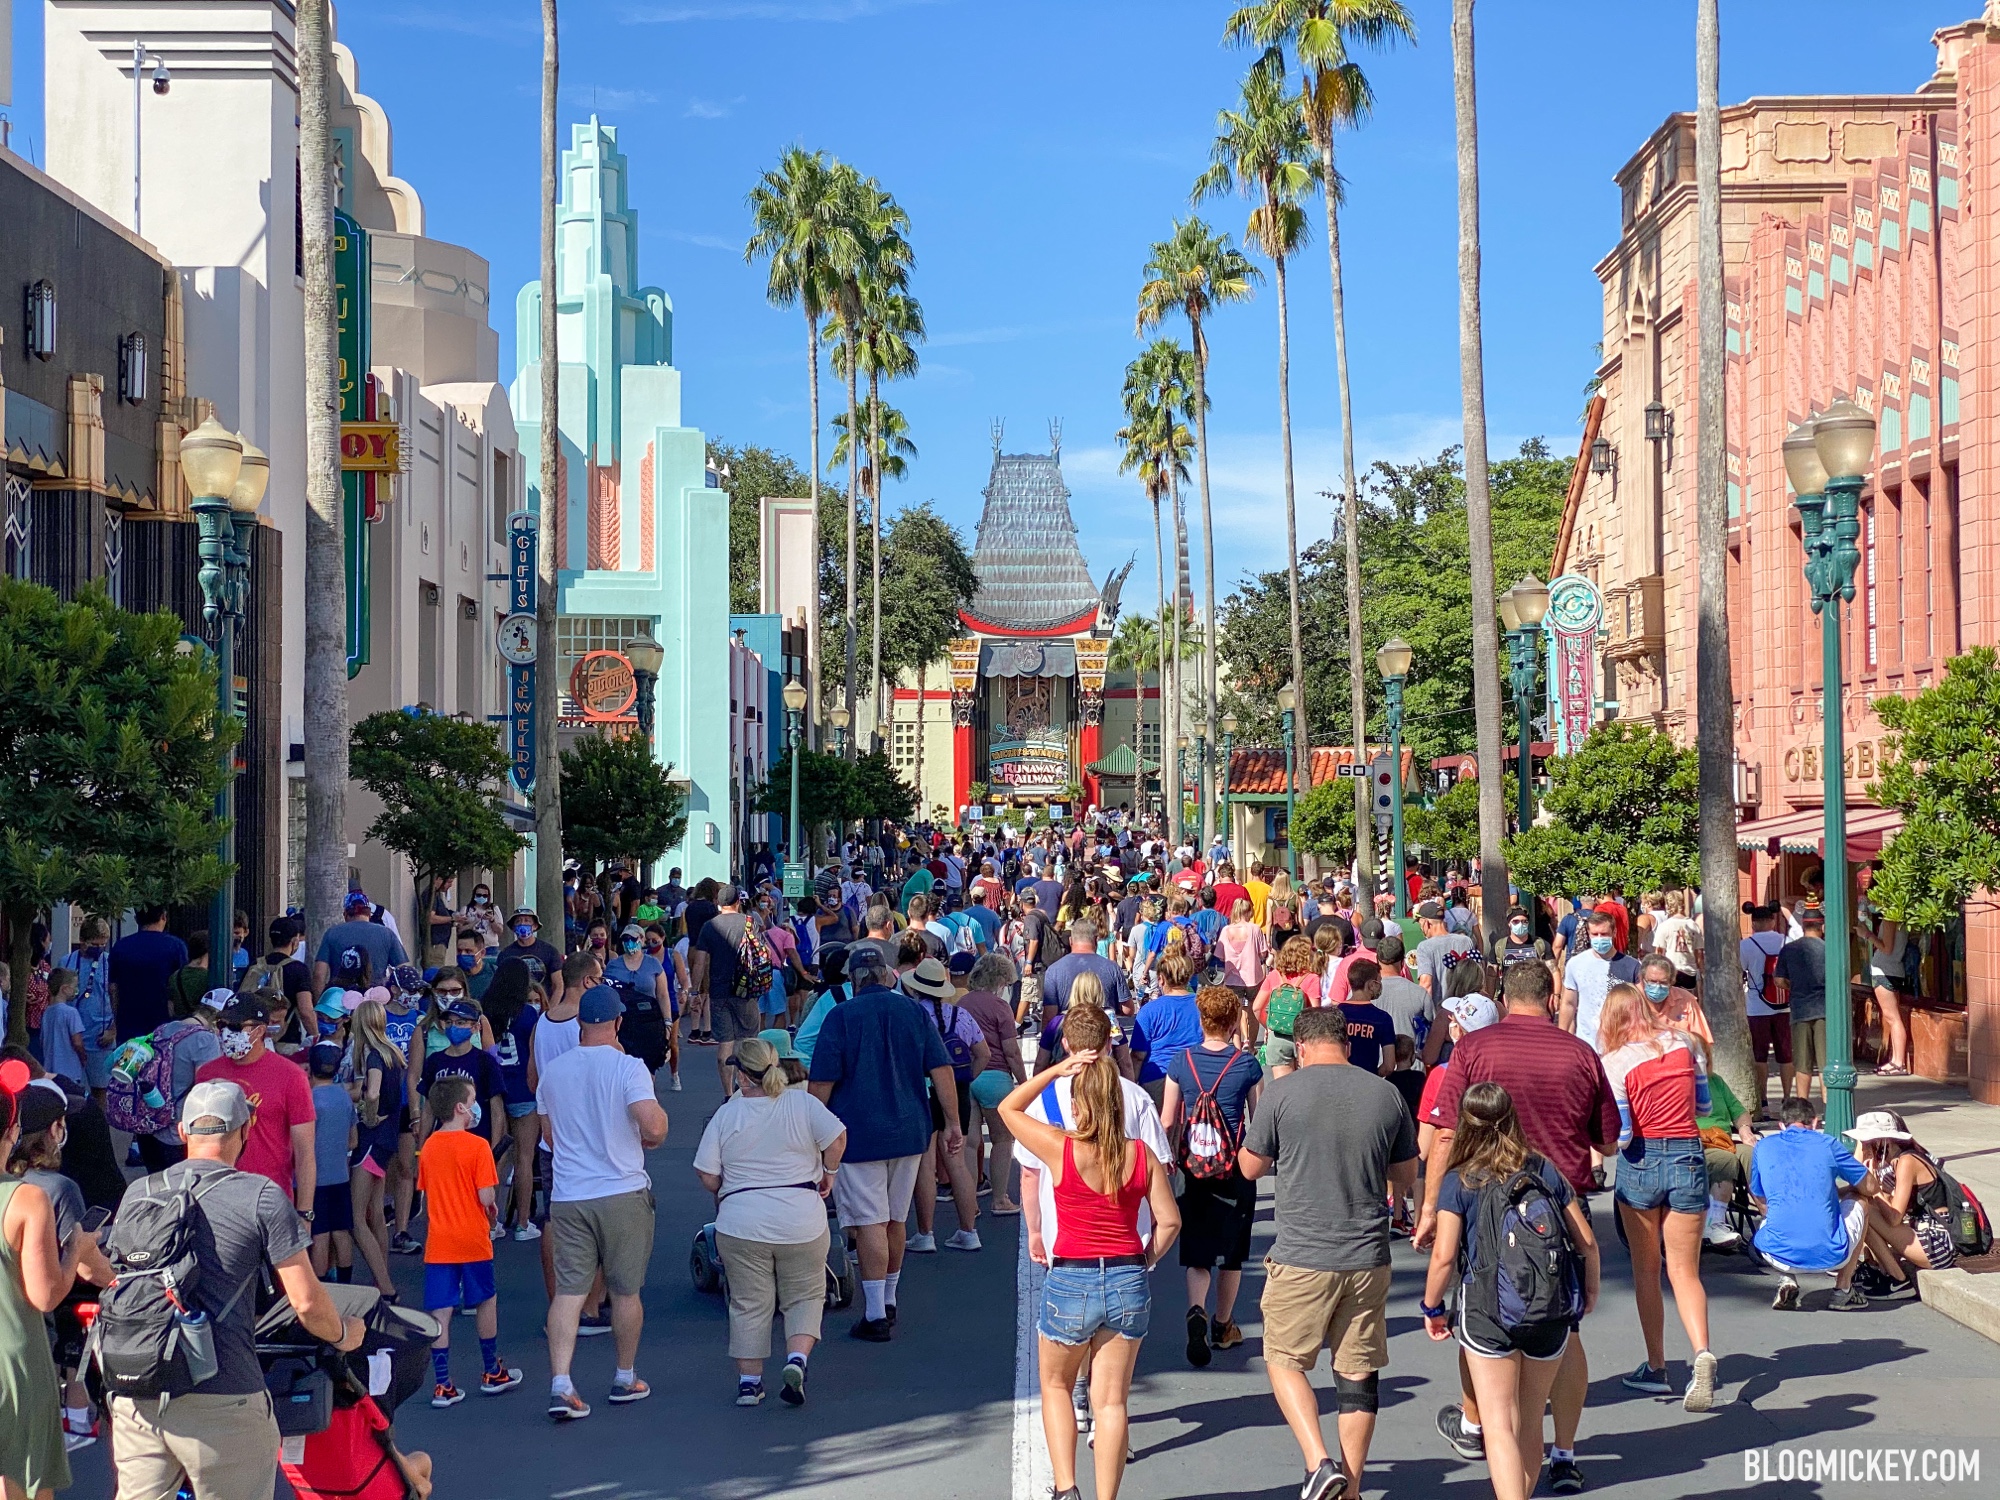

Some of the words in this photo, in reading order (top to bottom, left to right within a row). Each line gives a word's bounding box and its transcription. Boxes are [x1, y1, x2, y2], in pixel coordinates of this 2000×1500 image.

[340, 434, 391, 459] OY
[516, 535, 531, 608] GIFTS
[514, 670, 533, 780] JEWELRY
[1003, 763, 1057, 774] RUNAWAY
[1338, 764, 1366, 777] GO
[1004, 773, 1055, 786] RAILWAY
[1346, 1022, 1375, 1040] OPER
